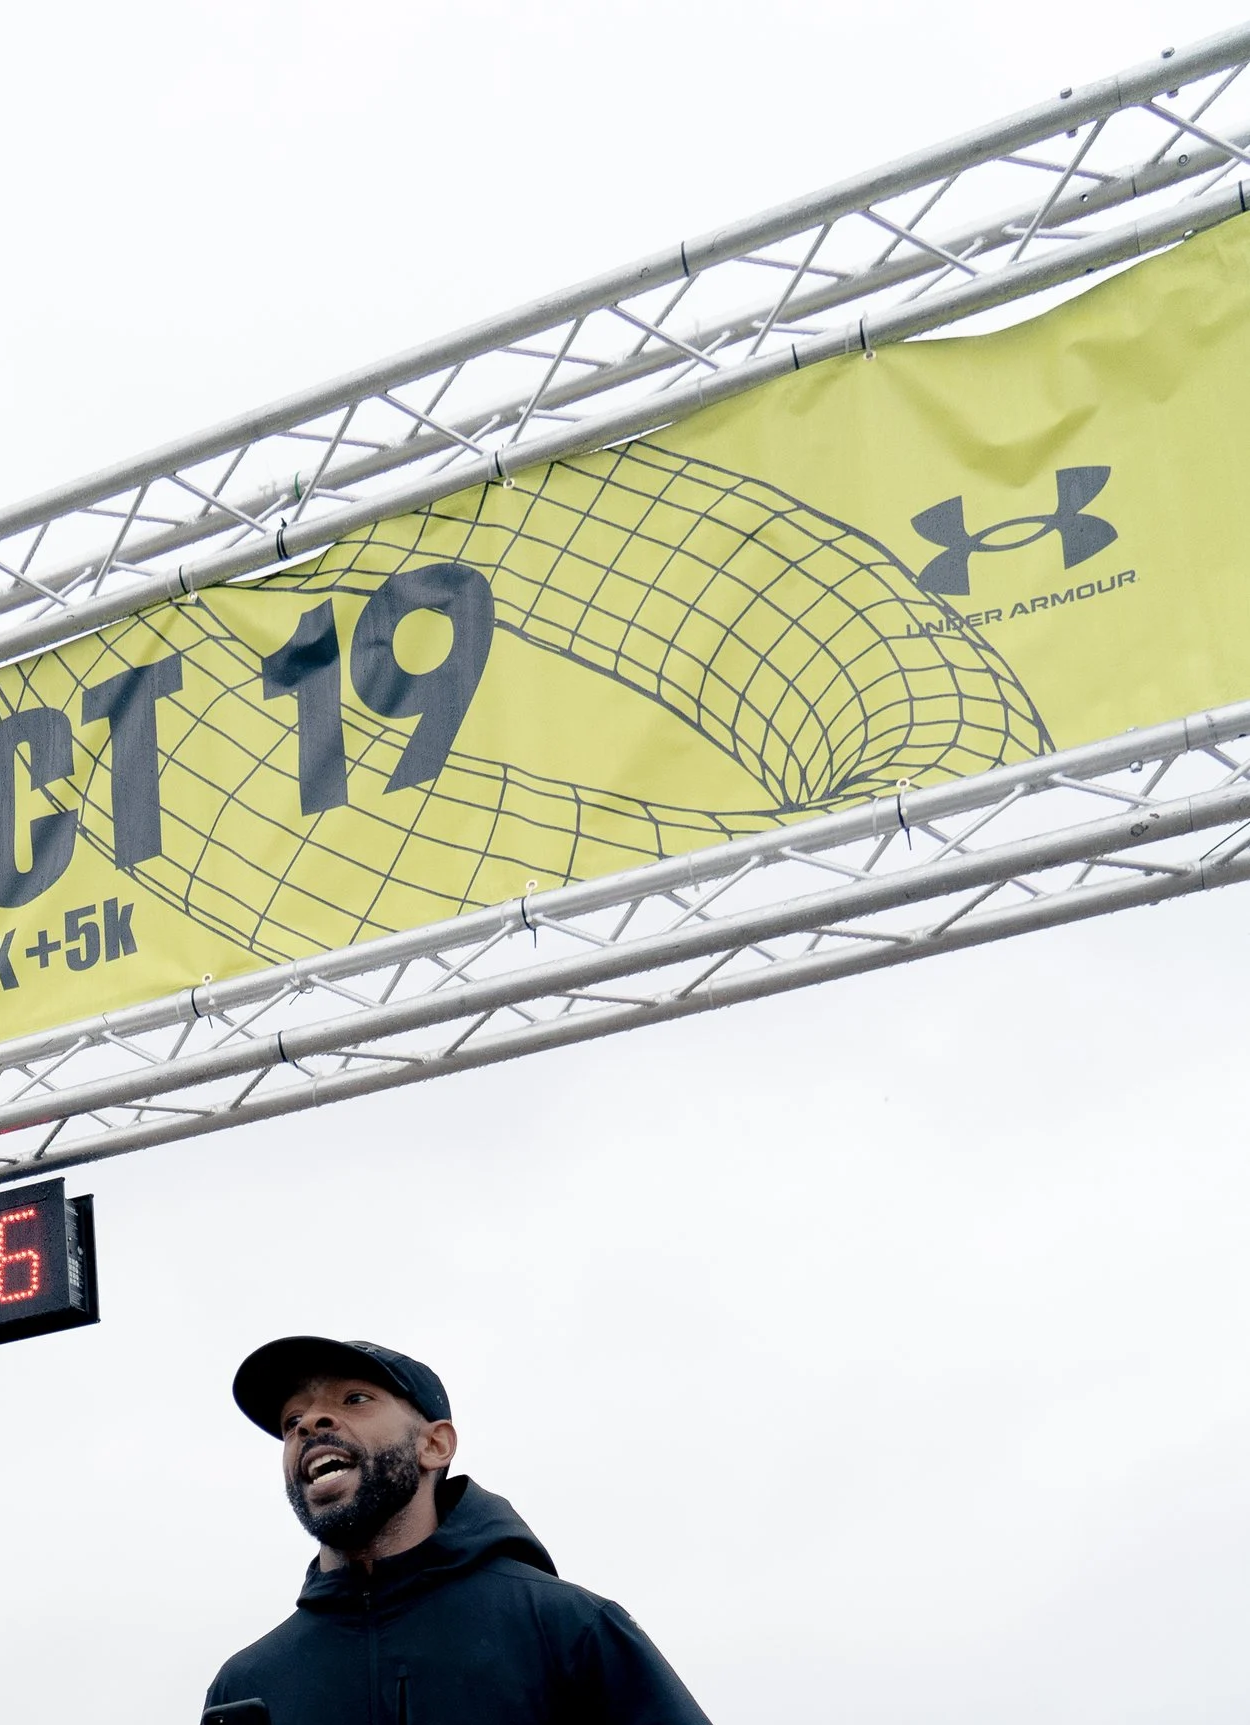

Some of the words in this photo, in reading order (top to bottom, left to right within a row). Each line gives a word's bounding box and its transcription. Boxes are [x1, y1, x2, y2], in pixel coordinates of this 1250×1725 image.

[906, 607, 1003, 637] UNDER
[1009, 569, 1137, 619] ARMOUR
[262, 563, 495, 816] 19
